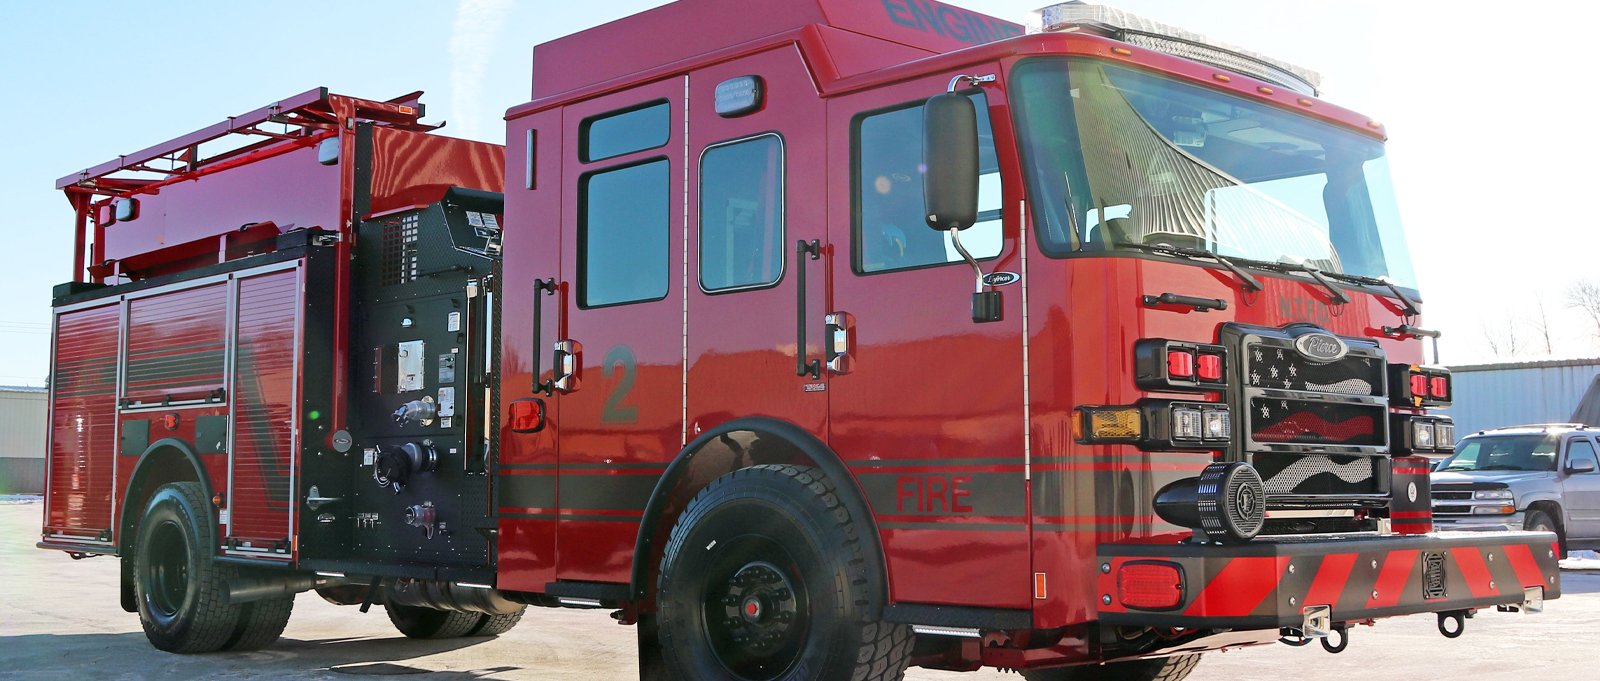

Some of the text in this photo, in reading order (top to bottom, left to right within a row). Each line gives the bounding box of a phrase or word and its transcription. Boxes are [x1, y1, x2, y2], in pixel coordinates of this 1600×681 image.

[1307, 337, 1338, 355] Pierce
[602, 345, 638, 424] 2
[896, 476, 973, 513] FIRE
